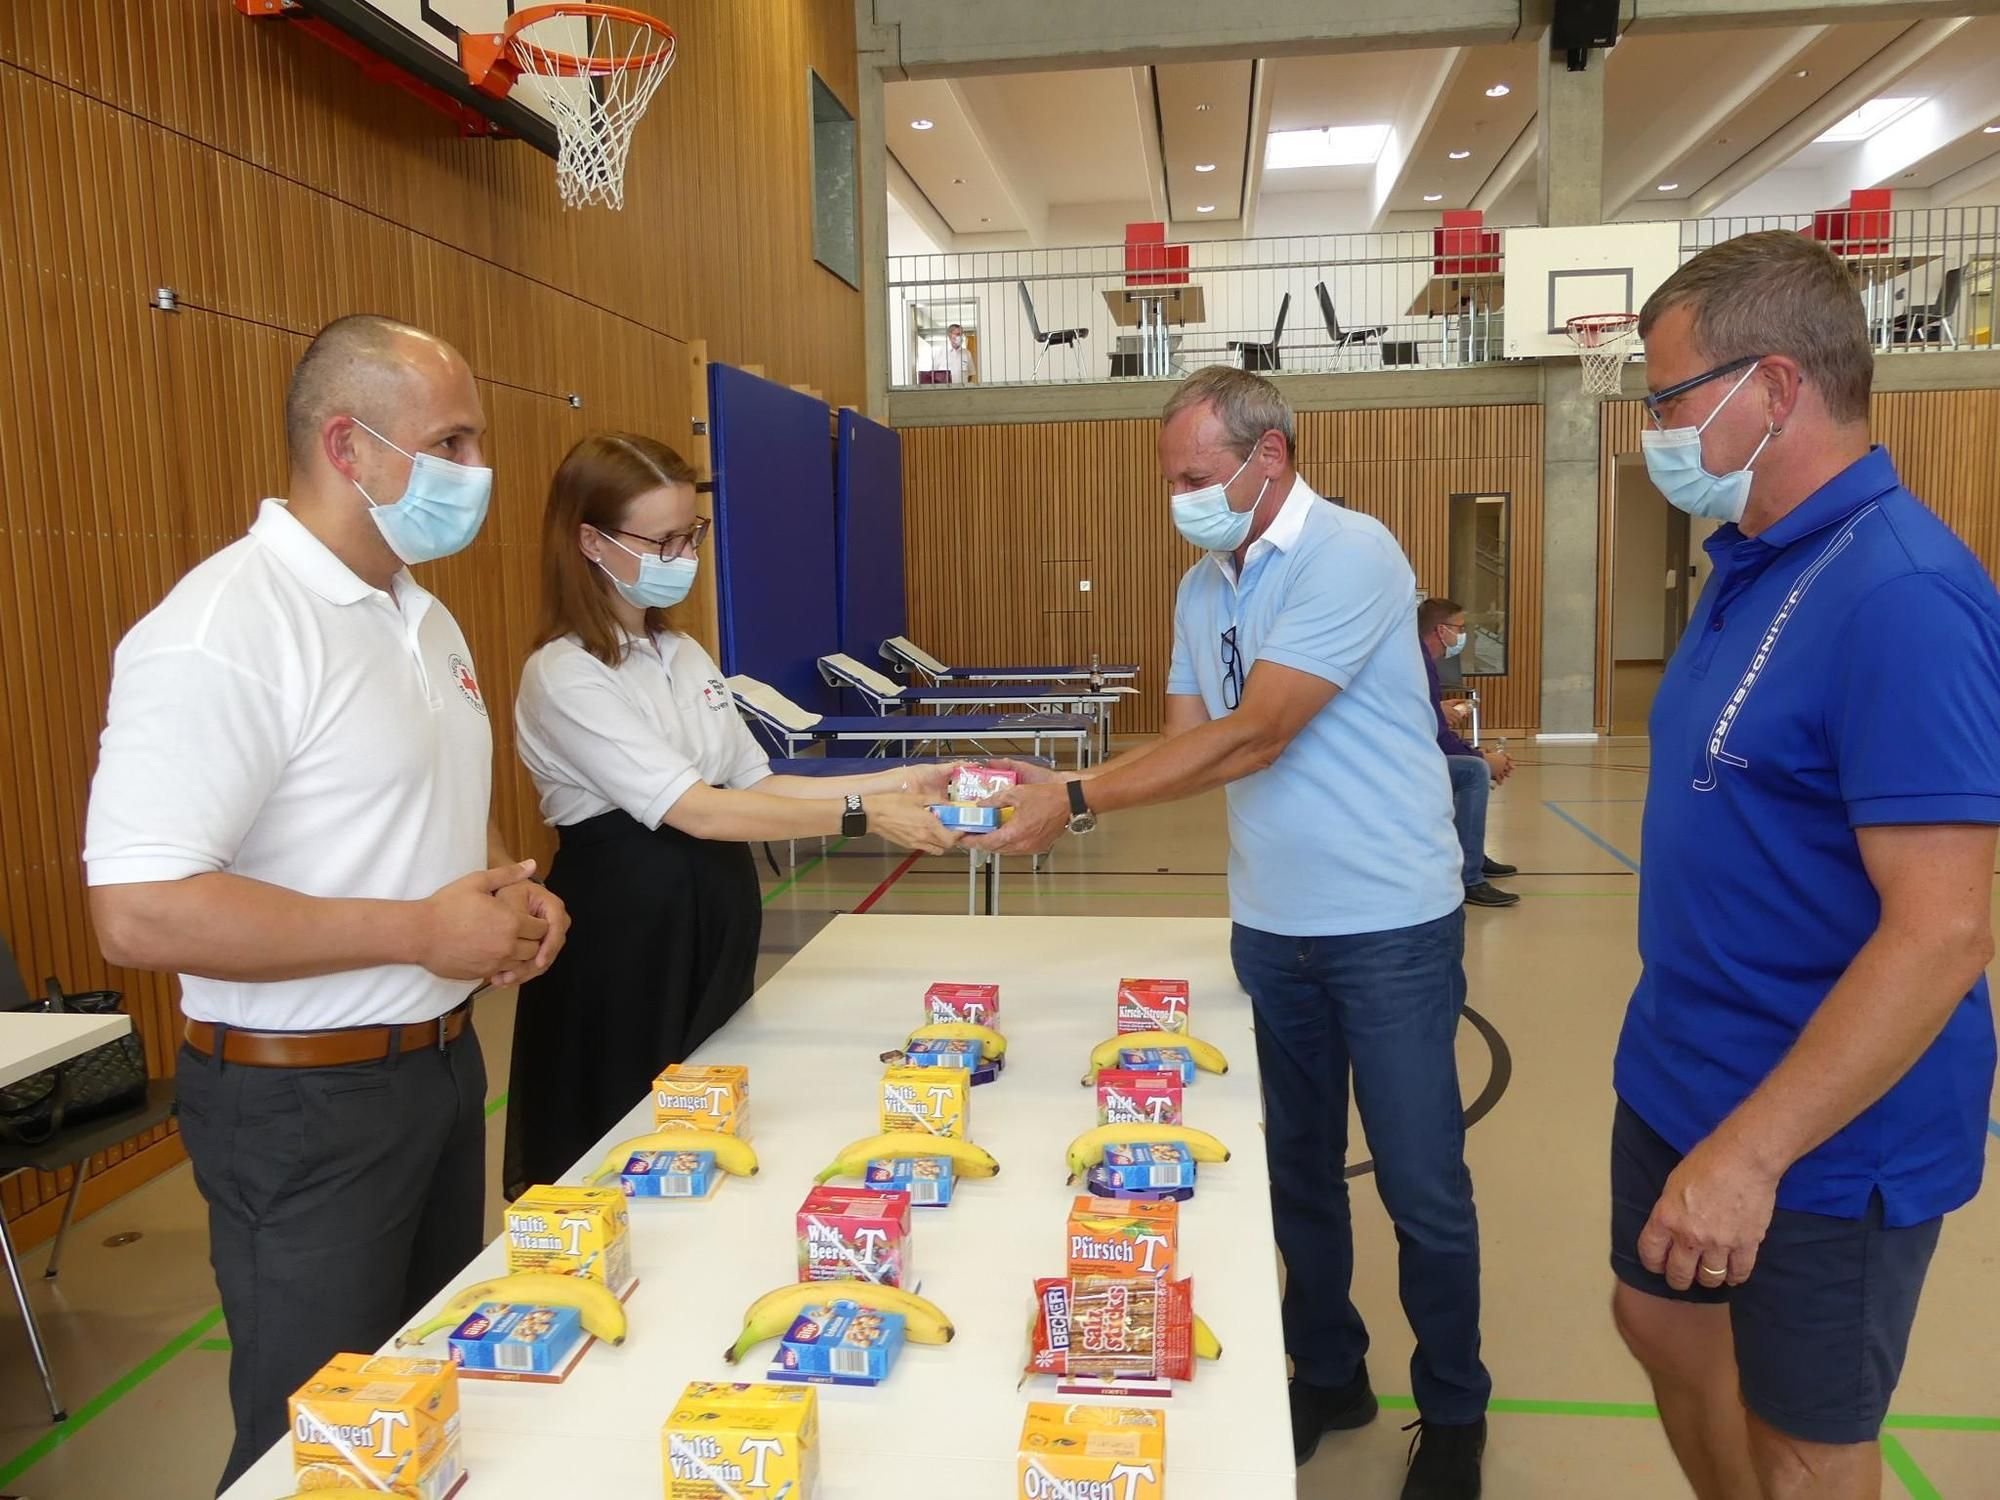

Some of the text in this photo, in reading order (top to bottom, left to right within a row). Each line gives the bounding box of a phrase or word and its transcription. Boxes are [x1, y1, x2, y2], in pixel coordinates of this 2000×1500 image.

[963, 1003, 984, 1024] T
[1161, 996, 1186, 1023] T
[657, 1087, 729, 1116] Orangen T
[928, 1087, 953, 1118] T
[1145, 1097, 1172, 1123] T
[508, 1215, 547, 1233] Multi-
[560, 1218, 592, 1255] T
[511, 1232, 563, 1250] Vitamin
[809, 1243, 854, 1260] Beeren
[854, 1228, 887, 1265] T
[1071, 1234, 1168, 1272] Pfirsich T
[1048, 1288, 1070, 1347] BECKER
[295, 1409, 409, 1458] Orangen T
[739, 1437, 784, 1487] T
[1024, 1462, 1156, 1500] Orangen T
